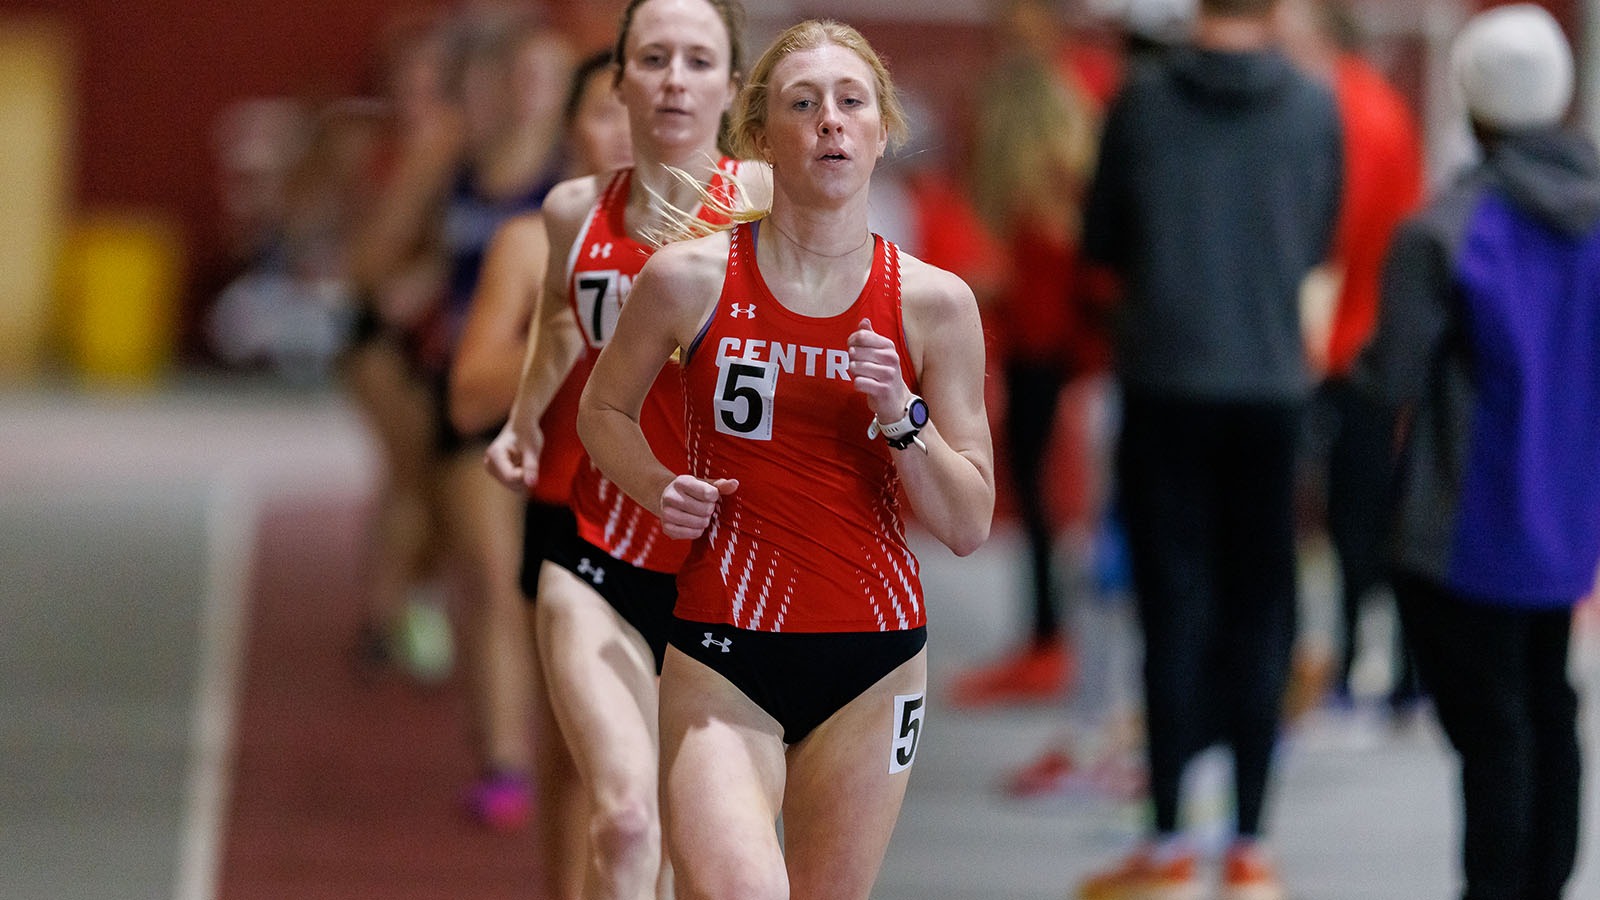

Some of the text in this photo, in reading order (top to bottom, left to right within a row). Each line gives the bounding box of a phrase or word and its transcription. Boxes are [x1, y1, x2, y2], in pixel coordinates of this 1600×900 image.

[580, 278, 608, 341] 7
[715, 337, 852, 381] CENTR
[720, 363, 766, 433] 5
[896, 696, 923, 766] 5
